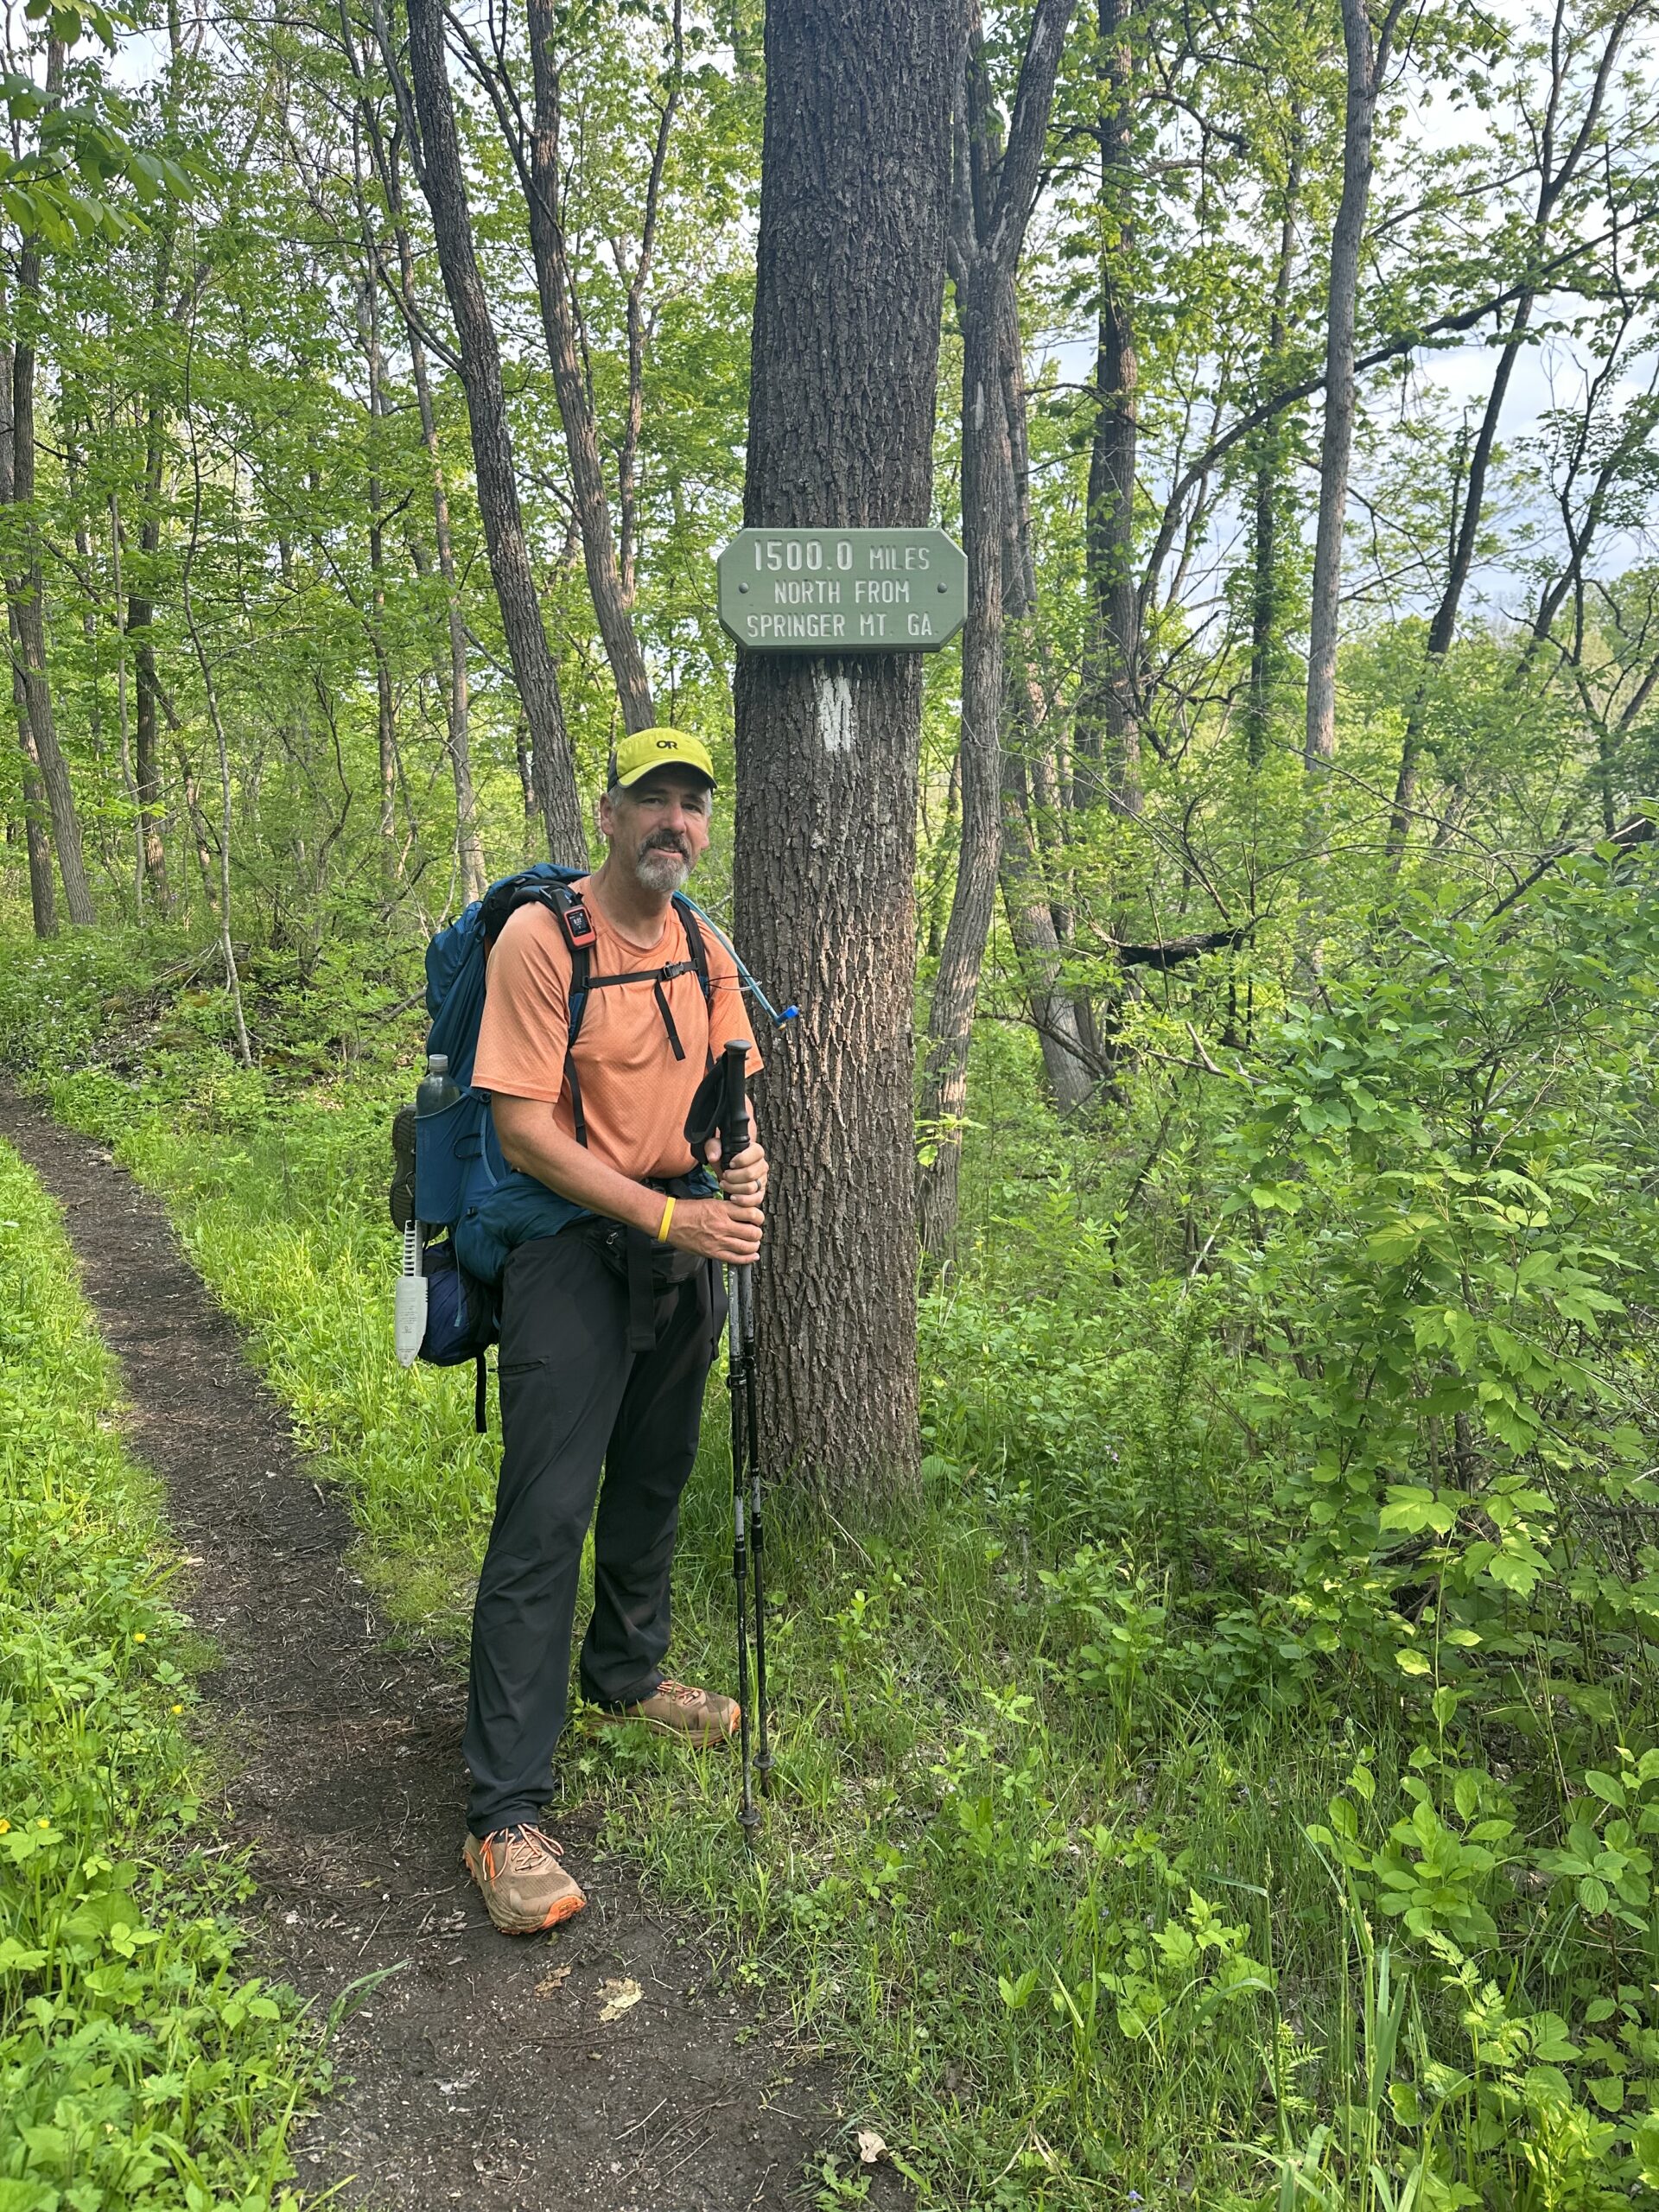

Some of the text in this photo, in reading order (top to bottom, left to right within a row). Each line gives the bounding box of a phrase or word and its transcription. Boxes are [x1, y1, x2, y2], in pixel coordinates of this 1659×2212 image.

[754, 539, 930, 571] 1500.0 MILES
[774, 580, 910, 604] NORTH FROM
[747, 613, 845, 638] SPRINGER
[656, 741, 679, 750] OR
